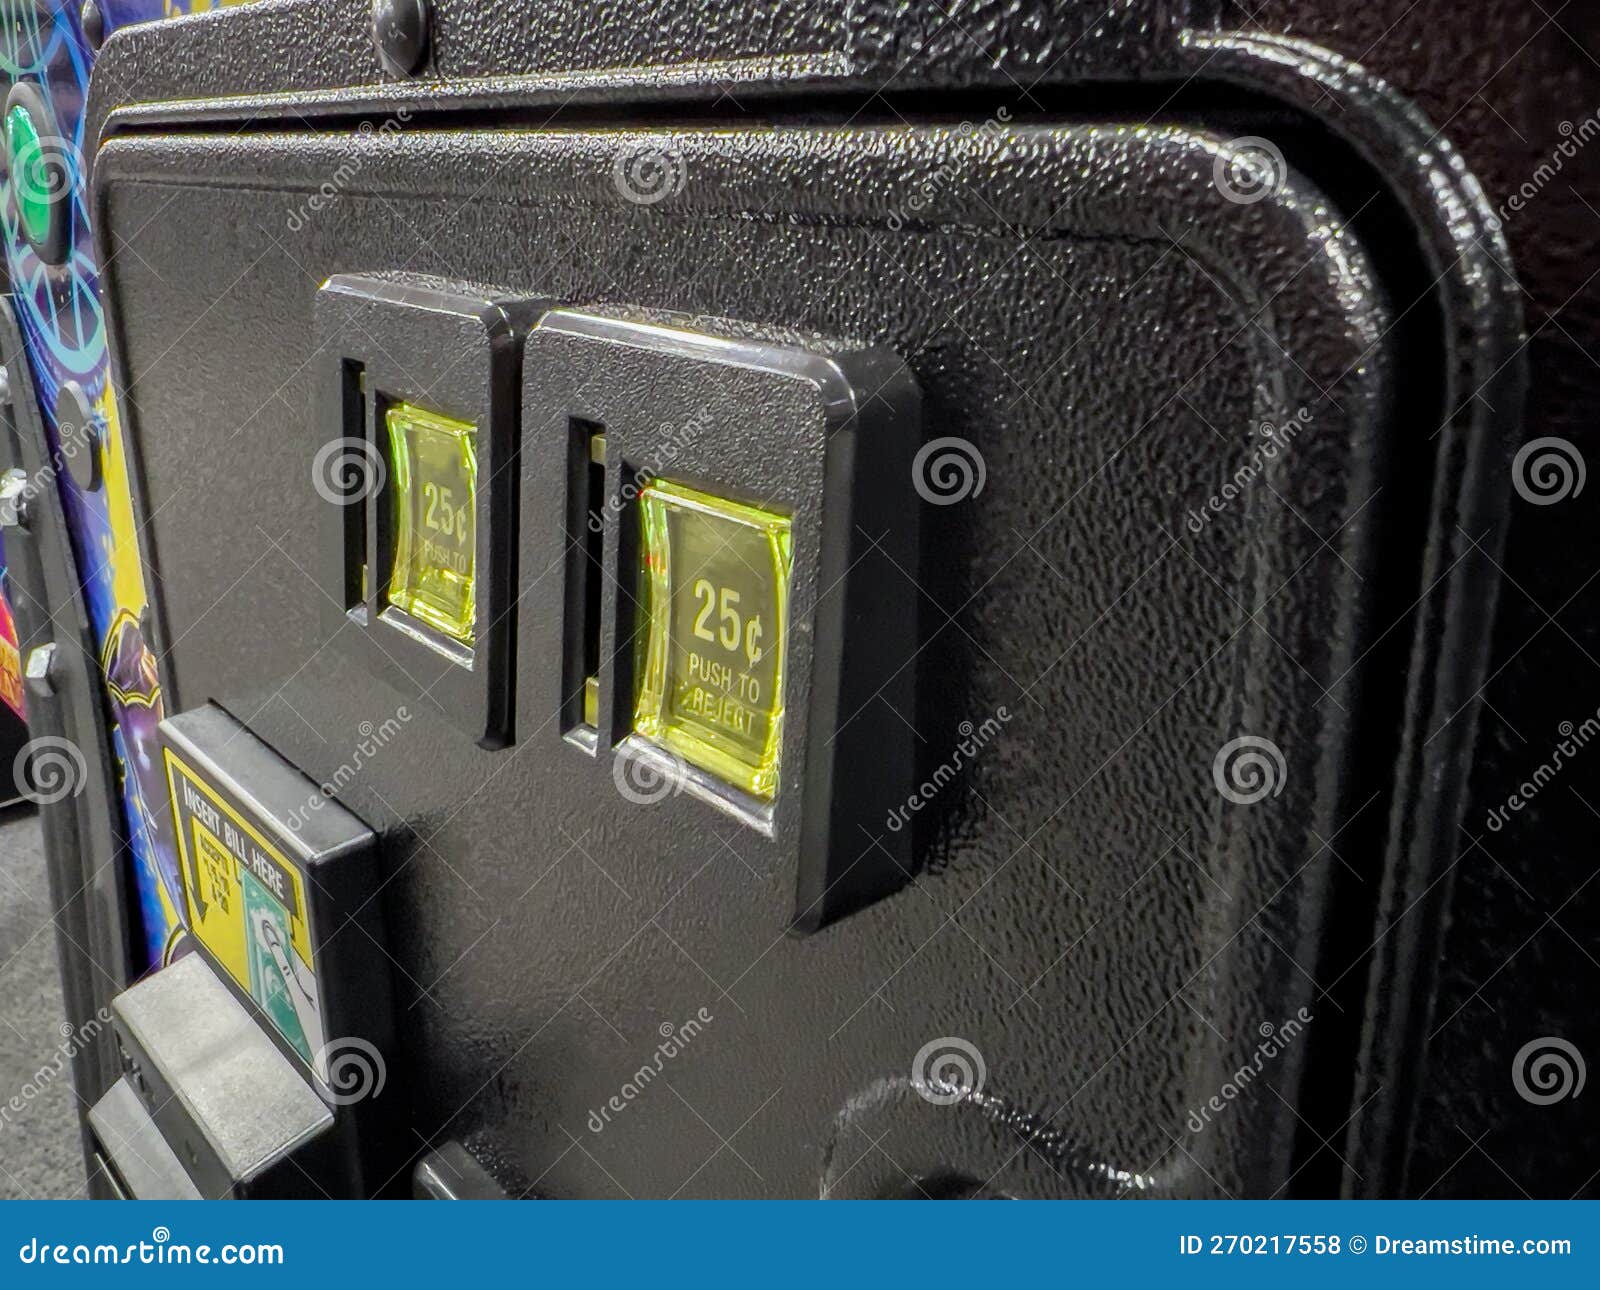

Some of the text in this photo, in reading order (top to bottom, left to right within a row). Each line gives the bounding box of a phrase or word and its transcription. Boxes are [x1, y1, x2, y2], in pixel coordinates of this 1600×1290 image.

[694, 579, 762, 668] 25¢
[689, 652, 760, 704] PUSH TO
[183, 775, 221, 835] INSERT
[224, 821, 249, 865] BILL
[252, 848, 284, 899] HERE
